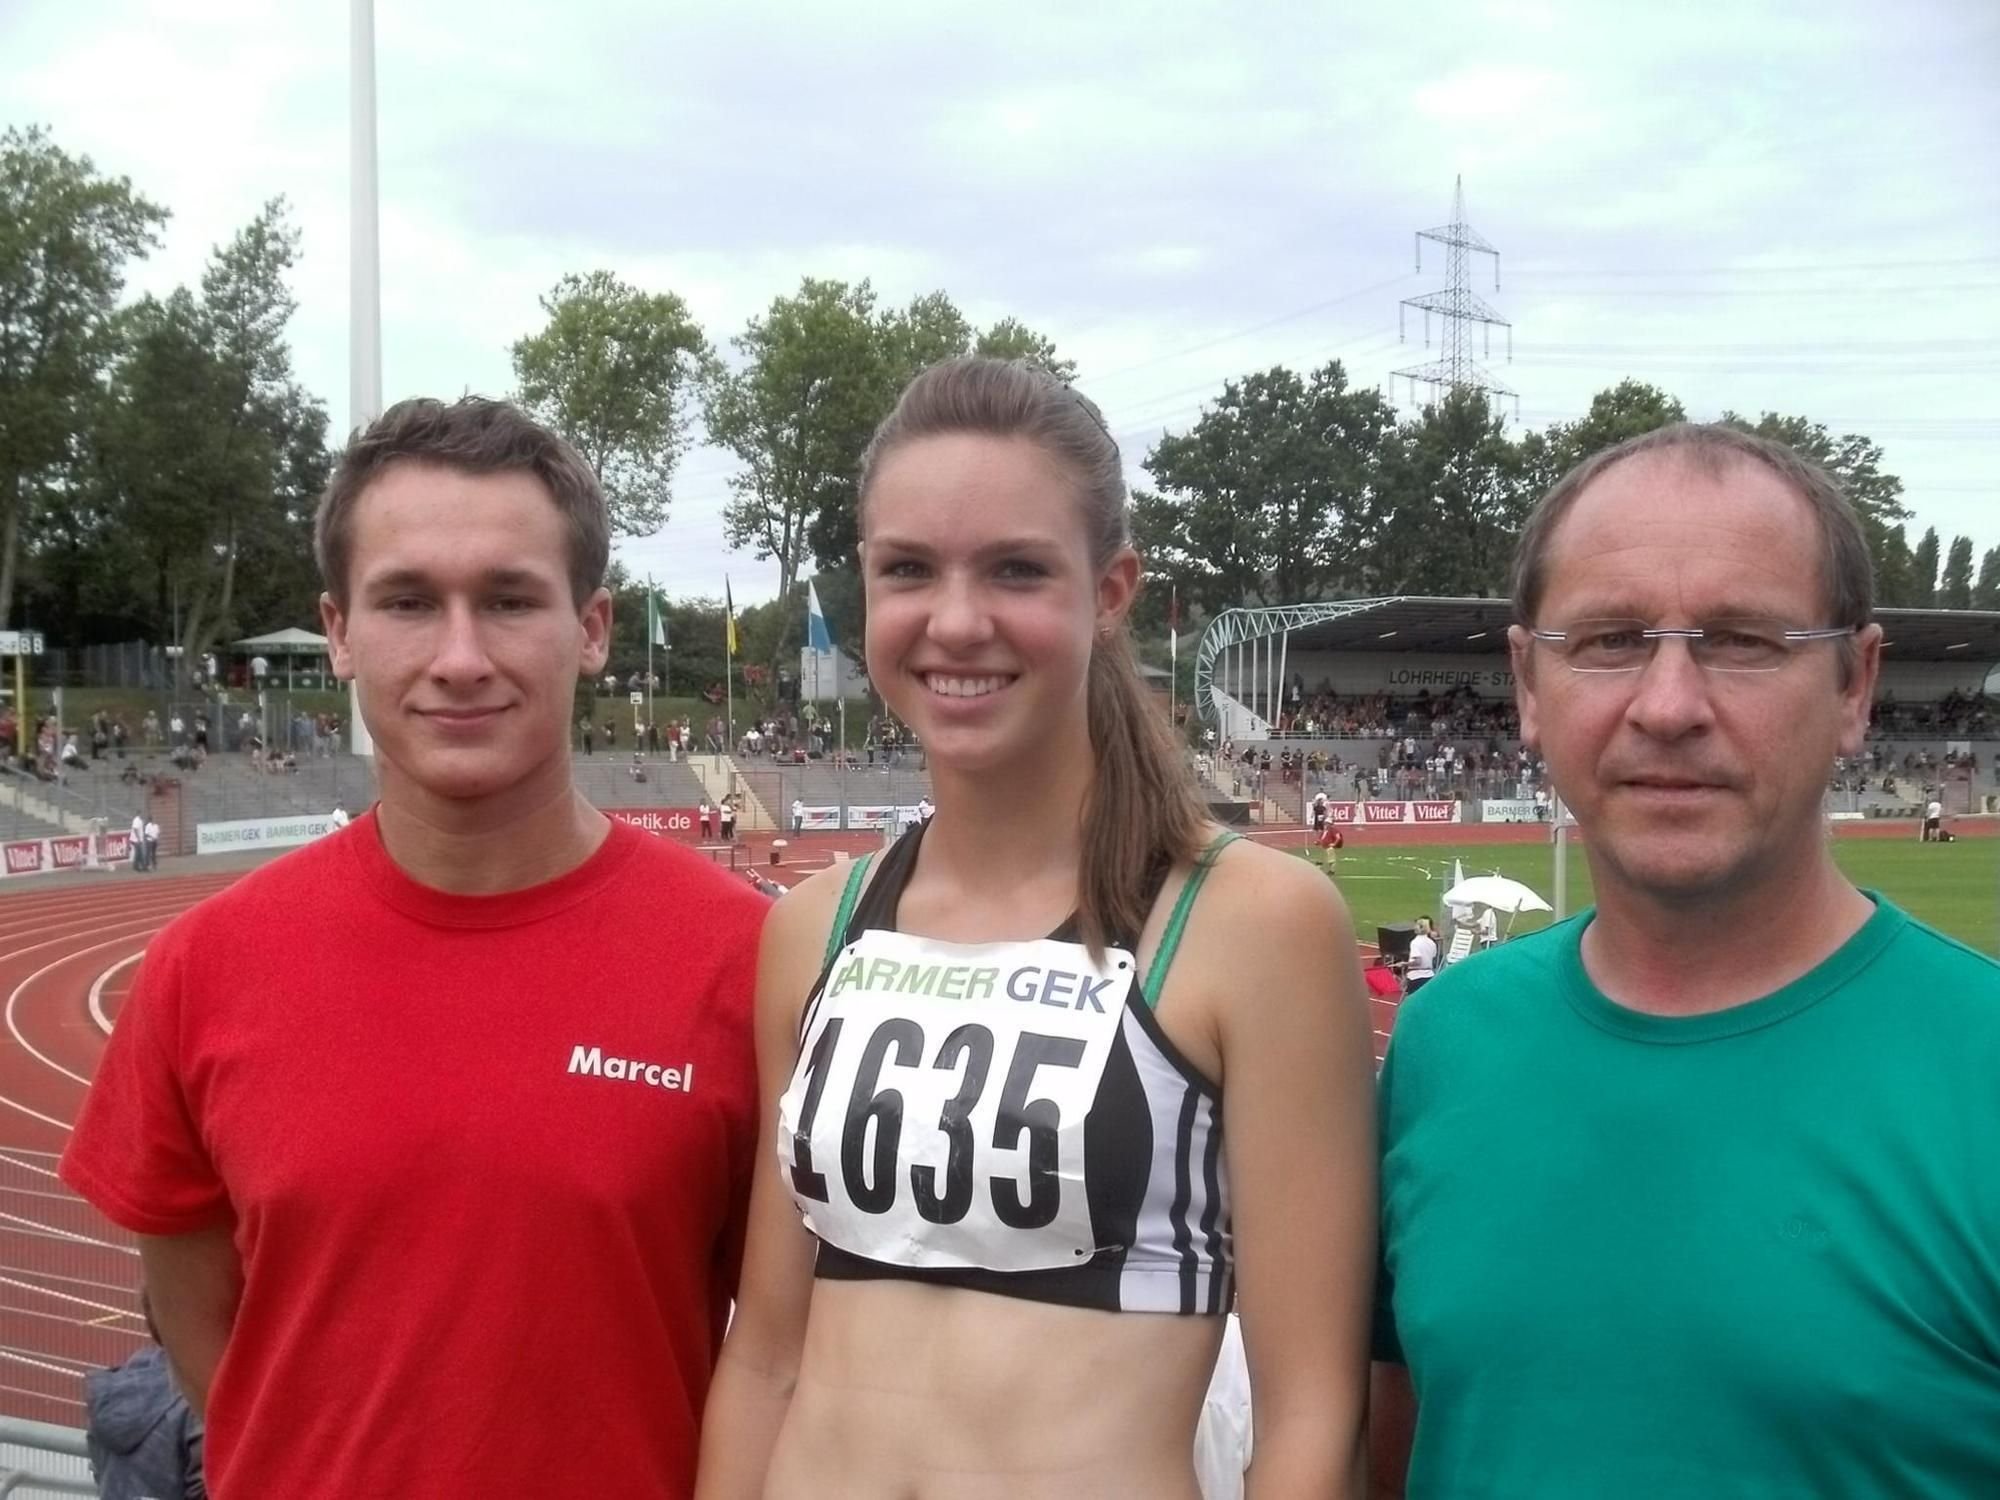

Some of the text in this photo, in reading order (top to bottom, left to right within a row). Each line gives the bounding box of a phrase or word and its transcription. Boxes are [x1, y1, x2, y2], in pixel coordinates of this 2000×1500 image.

[1367, 805, 1399, 820] Vittel
[1417, 805, 1450, 820] Vittel
[201, 828, 261, 846] BARMER GEK
[265, 823, 329, 840] BARMER GEK
[8, 845, 38, 869] Vittel
[1006, 965, 1114, 1014] GEK
[567, 1045, 694, 1093] Marcel
[789, 1016, 1088, 1230] 1635
